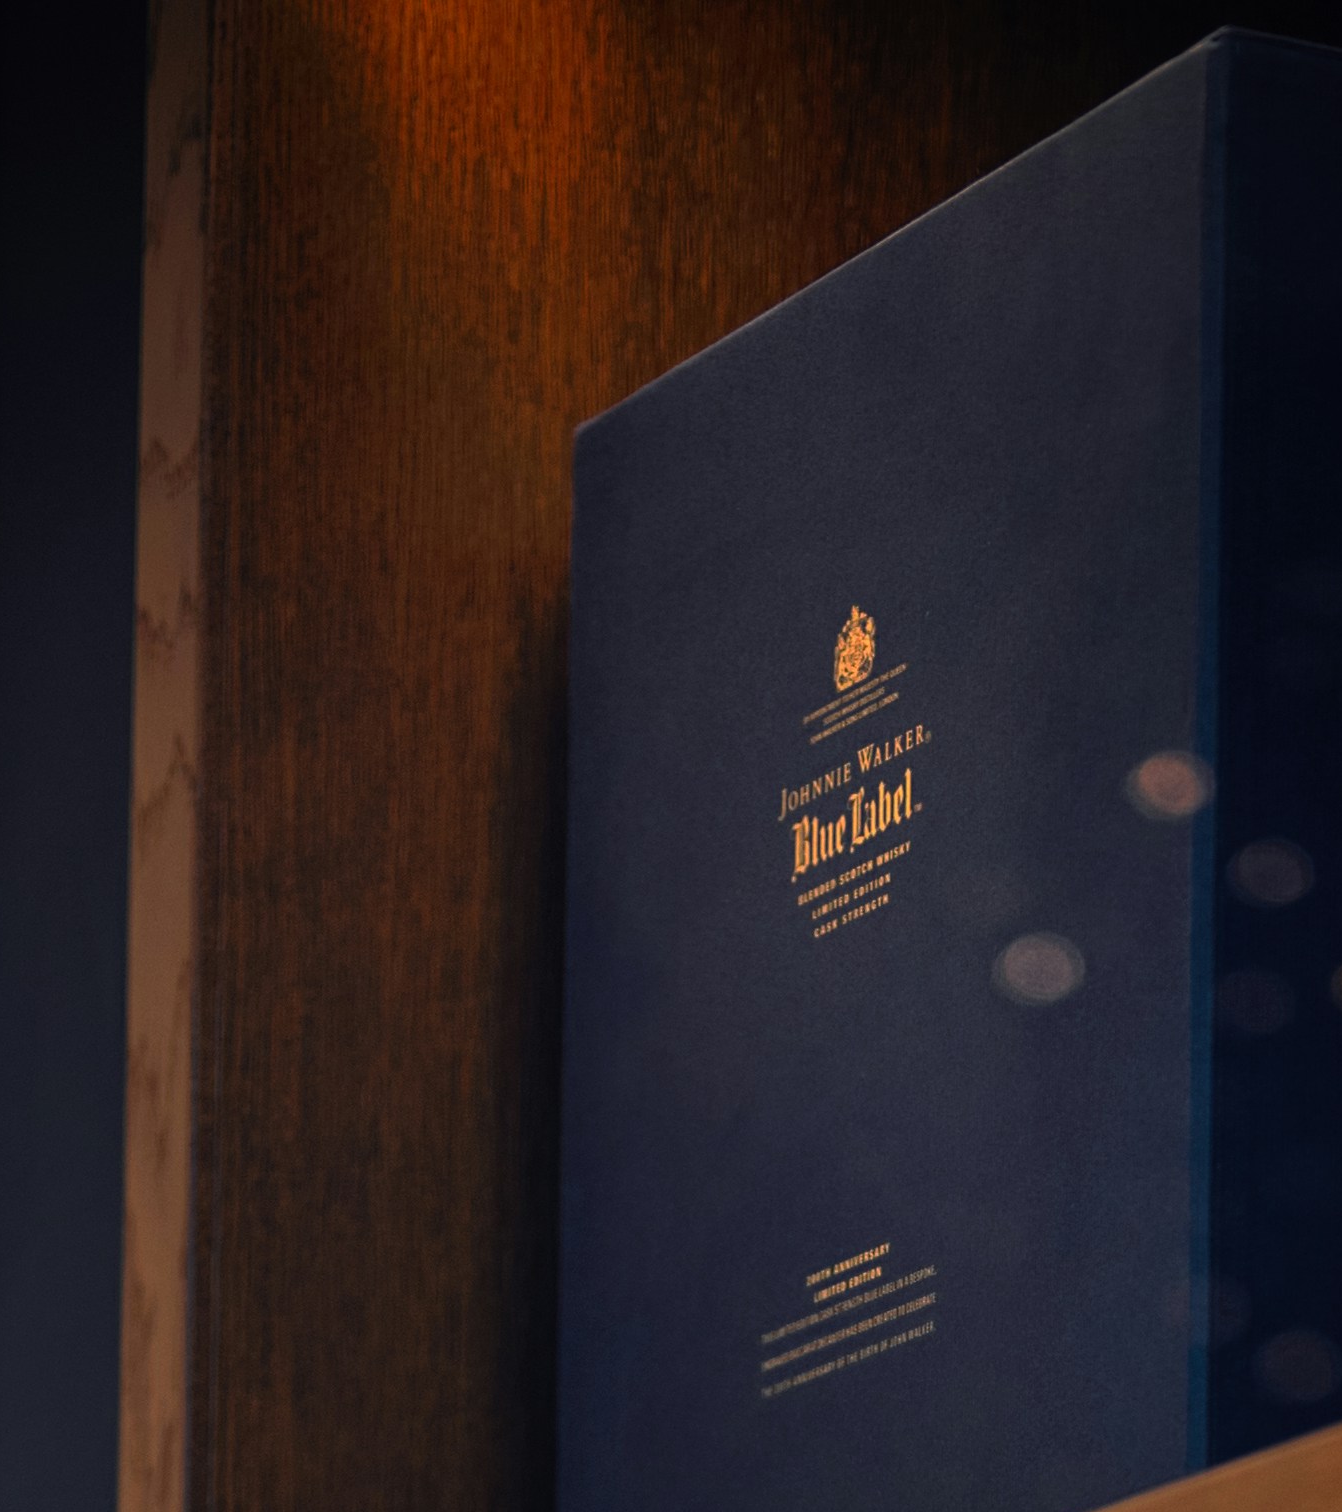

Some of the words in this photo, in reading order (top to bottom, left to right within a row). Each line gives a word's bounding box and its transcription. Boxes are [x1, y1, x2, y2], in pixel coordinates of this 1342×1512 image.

[777, 762, 851, 822] JOHNNIE
[790, 814, 847, 884] Blue
[847, 767, 913, 854] Label
[797, 878, 837, 906] BLENDED
[839, 860, 874, 886] SCOTCH
[876, 840, 911, 867] WHISKY
[811, 893, 849, 920] LIMITED
[853, 872, 891, 899] EDITION
[813, 918, 838, 938] CASK
[842, 893, 889, 925] STRENGTH
[833, 1242, 891, 1275] ANNIVERSARY
[813, 1281, 847, 1303] LIMITED
[848, 1266, 882, 1289] EDITION
